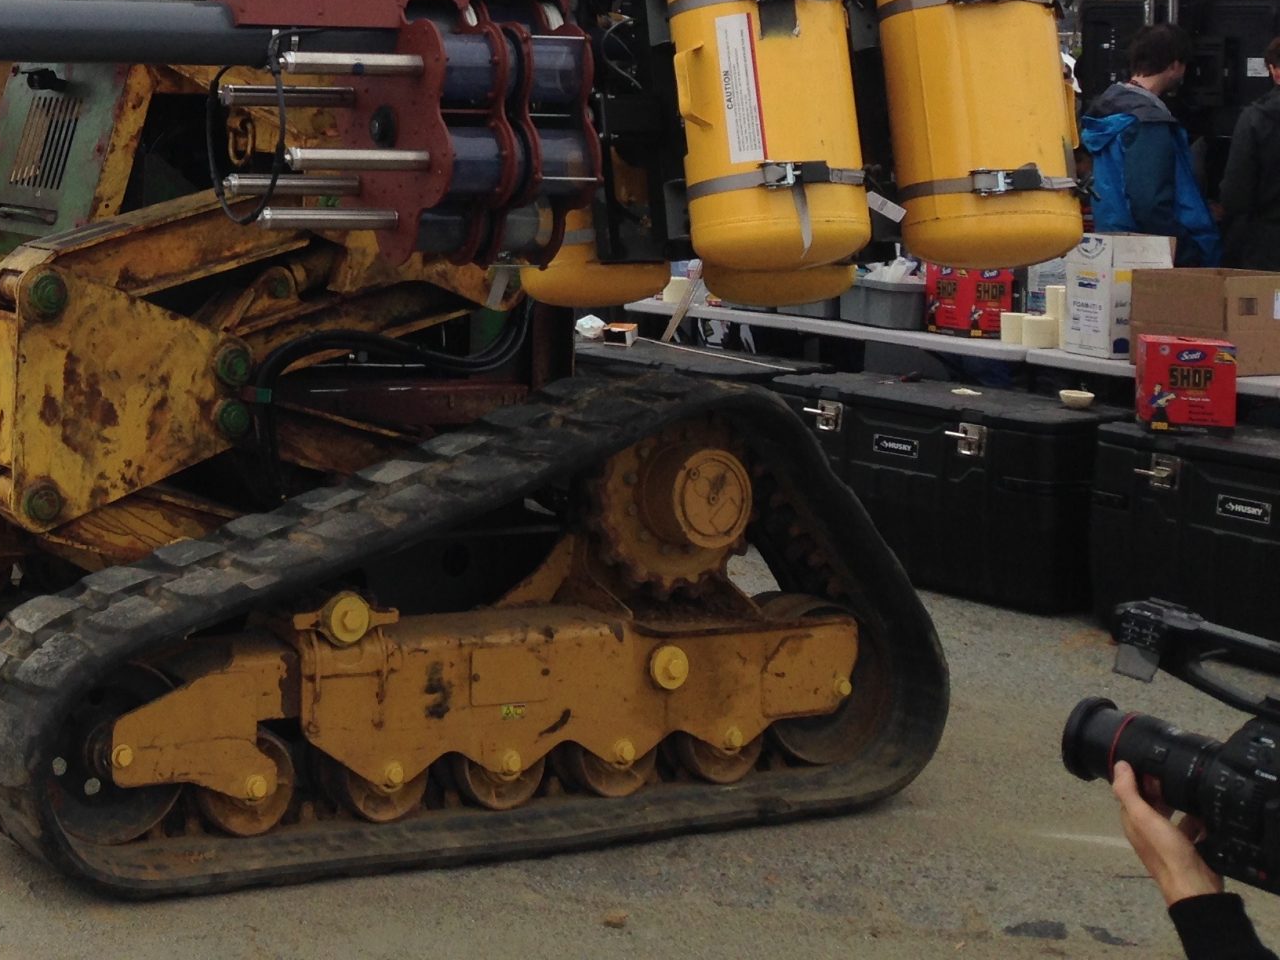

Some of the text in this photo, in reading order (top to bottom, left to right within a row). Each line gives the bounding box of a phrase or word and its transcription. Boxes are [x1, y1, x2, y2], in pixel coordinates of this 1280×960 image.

[723, 70, 733, 110] CAUTION
[977, 283, 1005, 300] SHOP
[1181, 351, 1201, 361] Scott
[1169, 366, 1213, 388] SHOP
[888, 441, 912, 451] HUSKY
[1235, 504, 1263, 516] HUSKY
